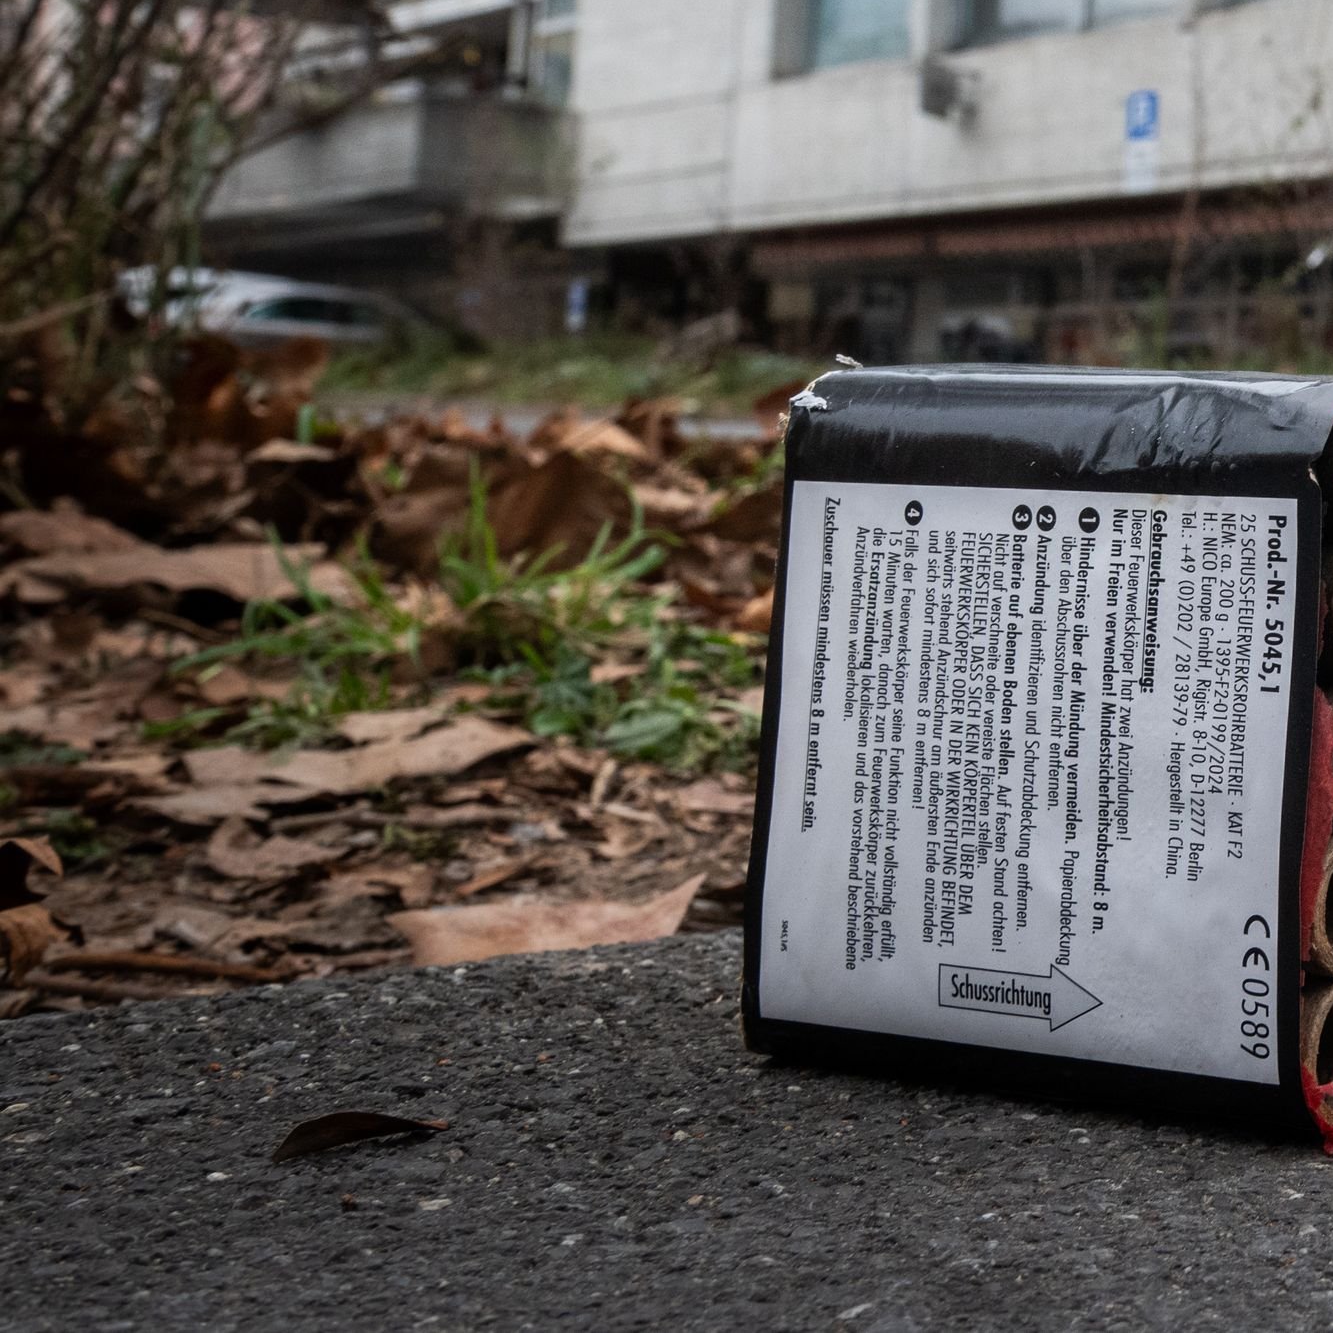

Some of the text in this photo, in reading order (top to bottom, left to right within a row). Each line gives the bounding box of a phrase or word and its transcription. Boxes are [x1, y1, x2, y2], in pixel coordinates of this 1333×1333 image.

[903, 562, 917, 583] der
[904, 529, 919, 558] Falls
[1011, 534, 1027, 589] Batterie
[1029, 534, 1052, 614] Anzündung
[1074, 536, 1096, 619] Hindernisse
[844, 526, 870, 721] Anzündverfahren wiederholen.
[1008, 593, 1024, 618] auf
[1073, 624, 1089, 657] über
[1141, 508, 1167, 693] Gebrauchsanweisung:
[1258, 514, 1287, 693] Prod.-Nr. 5045,1
[803, 496, 840, 832] Zuschauer müssen mindestens 8 m entfernt sein.
[892, 588, 915, 704] Feuerwerkskörper
[912, 530, 942, 809] und sich sofort mindestens 8 m entfernen!
[1004, 622, 1022, 674] ebenen
[1027, 619, 1047, 705] identifizieren
[1048, 536, 1077, 810] über den Abschussrohren nicht entfernen.
[1071, 661, 1087, 685] der
[1114, 509, 1147, 840] Dieser Feuerwerkskörper hat zwei Anzündungen!
[1207, 512, 1236, 794] NEM: ca. 200 g 1395-F2-0199/2024
[1228, 513, 1256, 859] 25 SCHUSS-FEUERWERKSROHRBATTERIE KAT F2
[891, 708, 905, 742] seine
[958, 532, 993, 915] SICHERSTELLEN, DASS SICH KEIN KÖRPERTEIL ÜBER DEM
[977, 533, 1010, 868] Nicht auf verschneite oder vereiste Flächen stellen.
[1001, 679, 1018, 724] Boden
[1025, 710, 1041, 735] und
[1064, 689, 1086, 758] Mündung
[1092, 508, 1128, 934] Nur im Freien verwenden! Mindestsicherheitsabstand: 8 m.
[1166, 510, 1197, 878] Tel.: +49 (0)202 / 28139-79 Hergestellt in China.
[1187, 512, 1218, 881] H.: NICO Europe GmbH, Rigistr. 8-10, D-12277 Berlin
[846, 527, 887, 970] die Ersatzanzündung lokalisieren und das vorstehend beschriebene
[860, 530, 903, 962] 15 Minuten warten, danach zum Feuerwerkskörper zurückkehren,
[888, 747, 904, 804] Funktion
[923, 530, 958, 943] seitwärts stehend Anzündschnur am äußersten Ende anzünden
[937, 531, 976, 947] FEUERWERKSKÖRPER ODER IN DER WIRKRICHTUNG BEFINDET,
[998, 728, 1015, 779] stellen.
[886, 808, 900, 841] nicht
[995, 811, 1011, 852] festen
[997, 784, 1012, 808] Auf
[1015, 740, 1040, 858] Schutzabdeckung
[1065, 763, 1082, 844] vermeiden.
[880, 844, 898, 915] vollständig
[994, 857, 1009, 897] Stand
[1016, 862, 1033, 931] entfernen.
[1055, 850, 1079, 965] Papierabdeckung
[878, 919, 896, 962] erfüllt,
[992, 901, 1008, 952] achten!
[951, 973, 1050, 1015] Schussrichtung
[1240, 977, 1270, 1059] 0589
